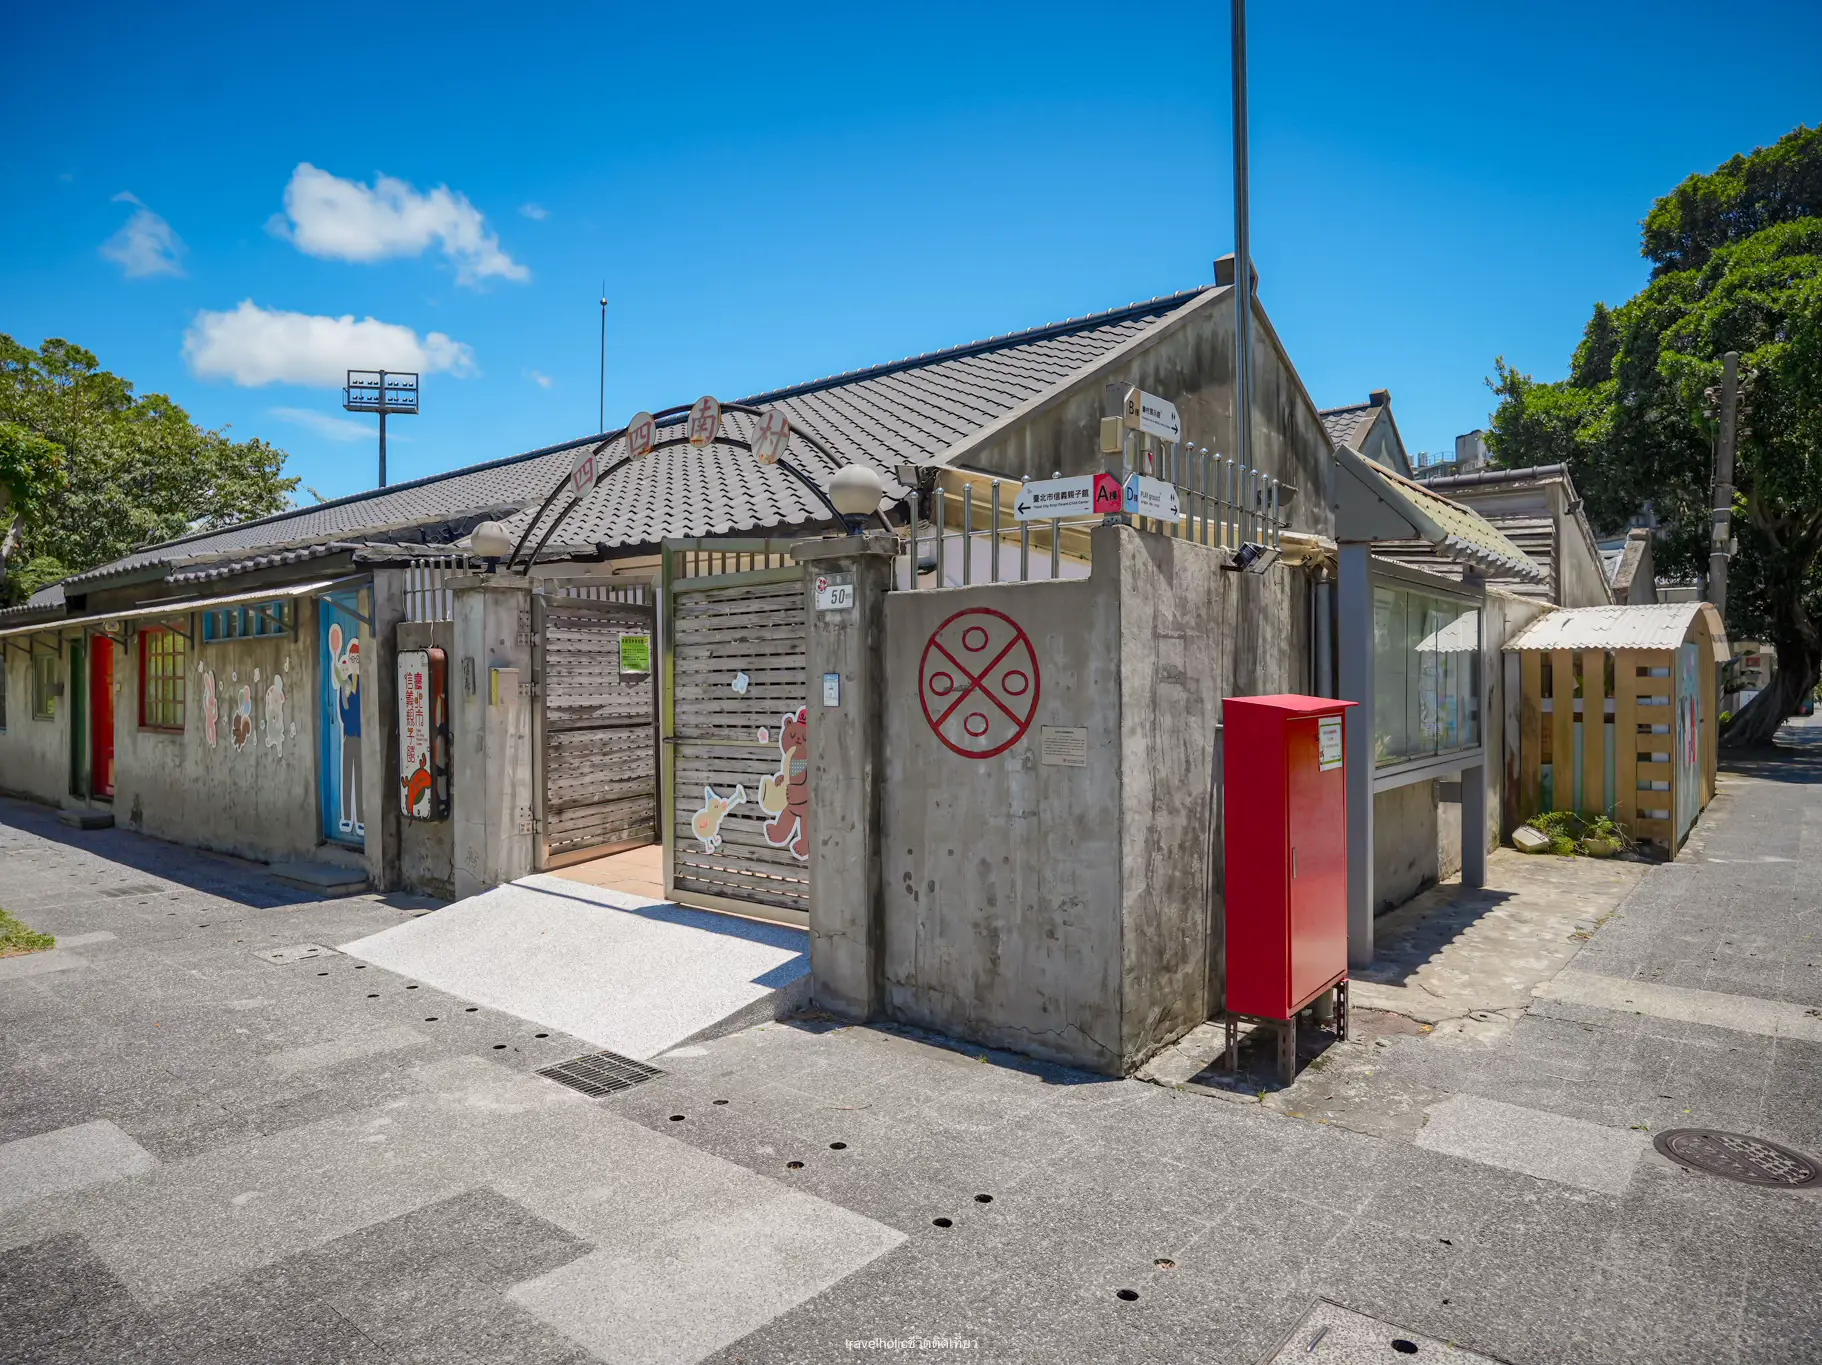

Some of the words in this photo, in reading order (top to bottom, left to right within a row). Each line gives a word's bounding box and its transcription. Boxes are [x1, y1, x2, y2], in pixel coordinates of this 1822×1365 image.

[1033, 488, 1089, 503] 臺北市信義親子館
